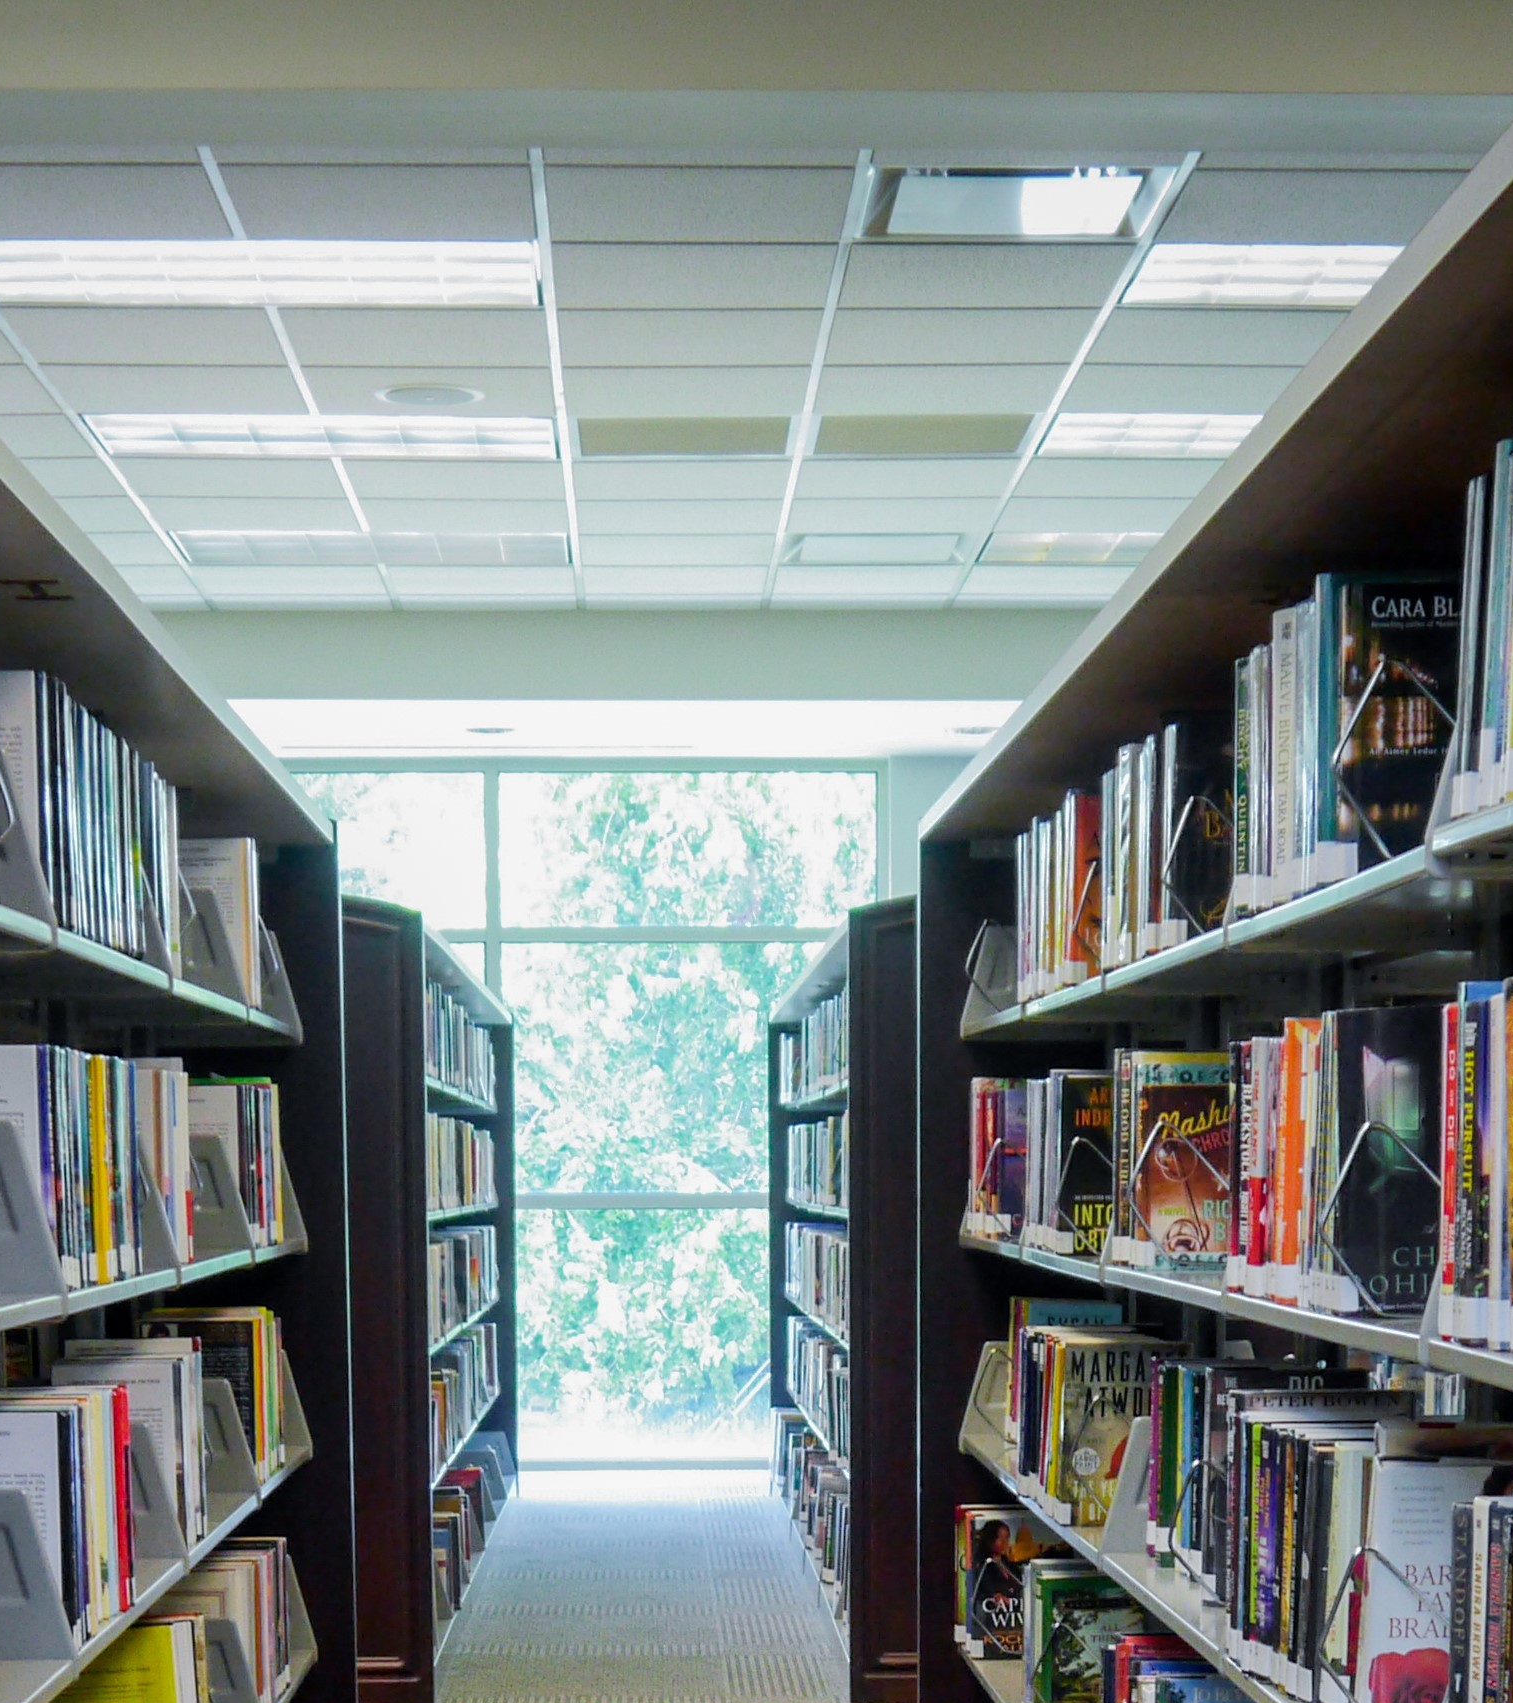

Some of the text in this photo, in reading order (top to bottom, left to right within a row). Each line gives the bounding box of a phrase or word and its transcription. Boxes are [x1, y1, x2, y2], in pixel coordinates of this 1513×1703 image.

[1371, 595, 1426, 619] CARA
[1277, 652, 1292, 784] MAEVE BINCHY
[1275, 793, 1288, 864] TARA ROAD
[1120, 1088, 1132, 1141] BLOOD
[1239, 1083, 1252, 1181] BLACKSTOCK
[1447, 1049, 1457, 1151] DO DIE
[1461, 1051, 1475, 1192] HOT PURSUIT
[1248, 1394, 1317, 1408] PETER
[1453, 1514, 1468, 1657] STANDOFF
[1472, 1551, 1484, 1682] SANDRA BROWN
[1487, 1542, 1504, 1689] SANDRA BROWN
